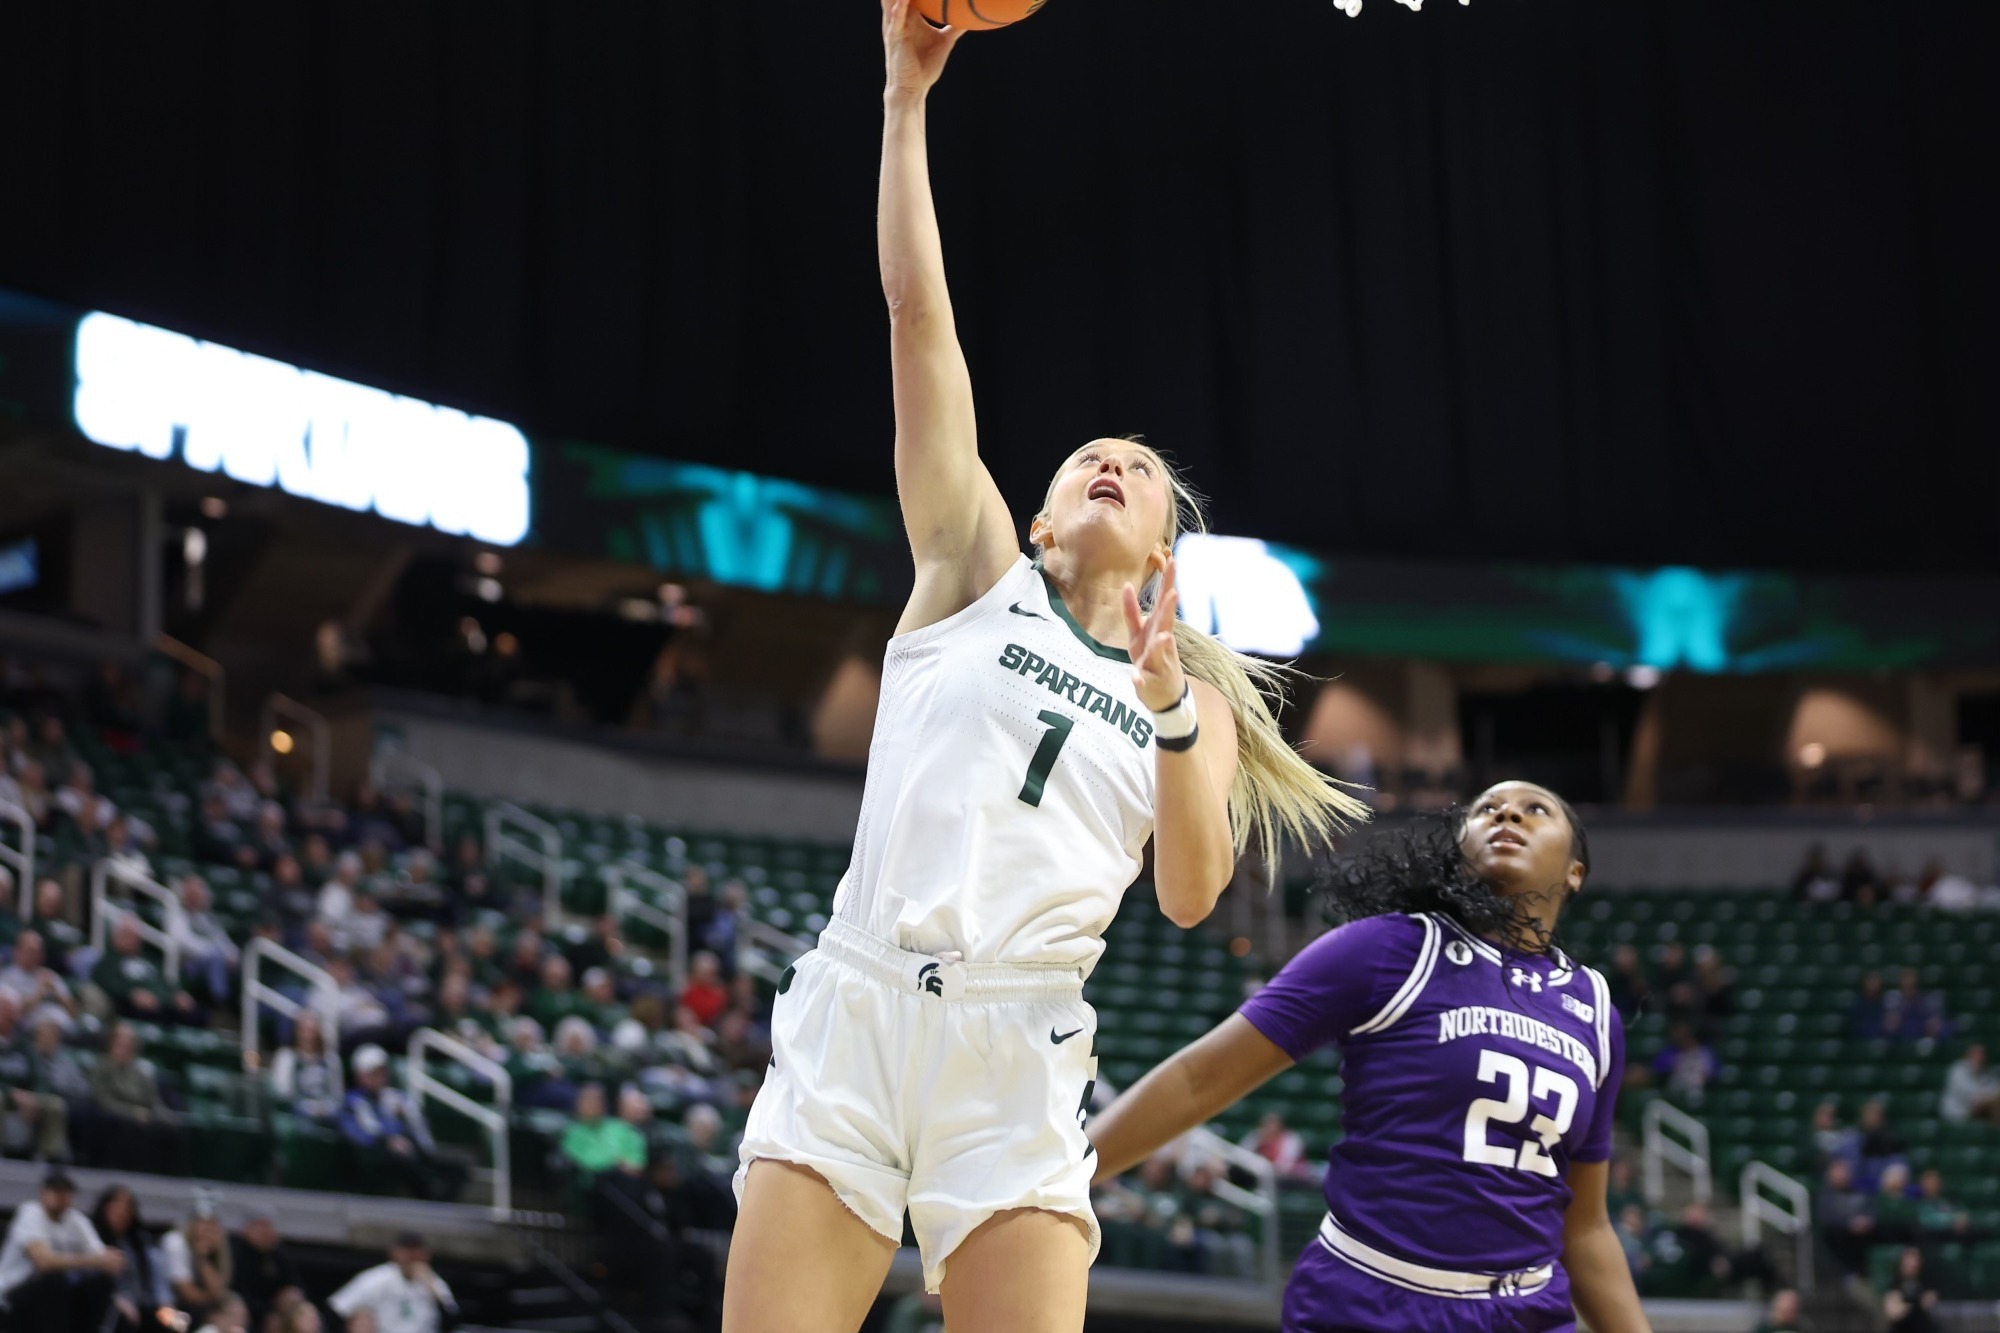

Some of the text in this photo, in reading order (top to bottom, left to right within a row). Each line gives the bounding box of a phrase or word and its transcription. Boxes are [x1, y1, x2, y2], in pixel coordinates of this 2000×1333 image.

[998, 643, 1154, 749] SPARTANS
[1017, 709, 1075, 808] 1
[1463, 1048, 1579, 1178] 23
